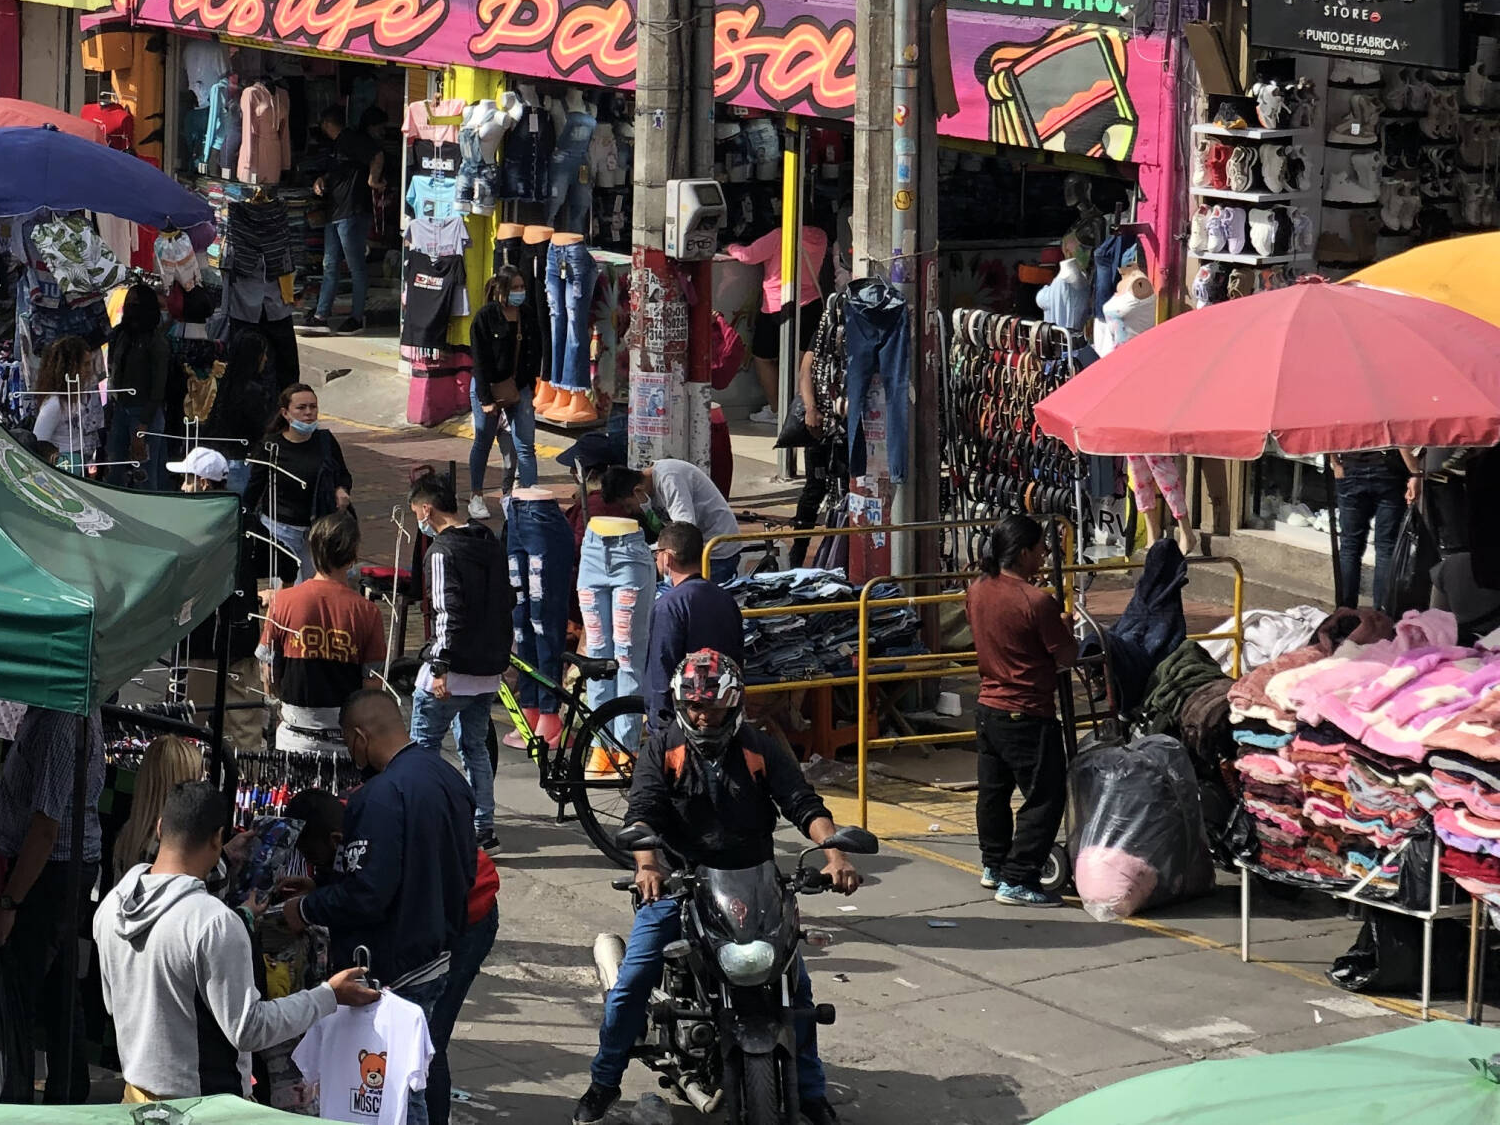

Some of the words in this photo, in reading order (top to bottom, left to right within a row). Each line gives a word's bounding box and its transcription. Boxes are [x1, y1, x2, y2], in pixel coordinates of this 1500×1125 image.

[1323, 5, 1369, 20] STORE
[1306, 29, 1339, 44] PUNTO
[1341, 32, 1355, 46] DE
[1356, 35, 1400, 50] FABRICA
[353, 1092, 382, 1114] MOSC
